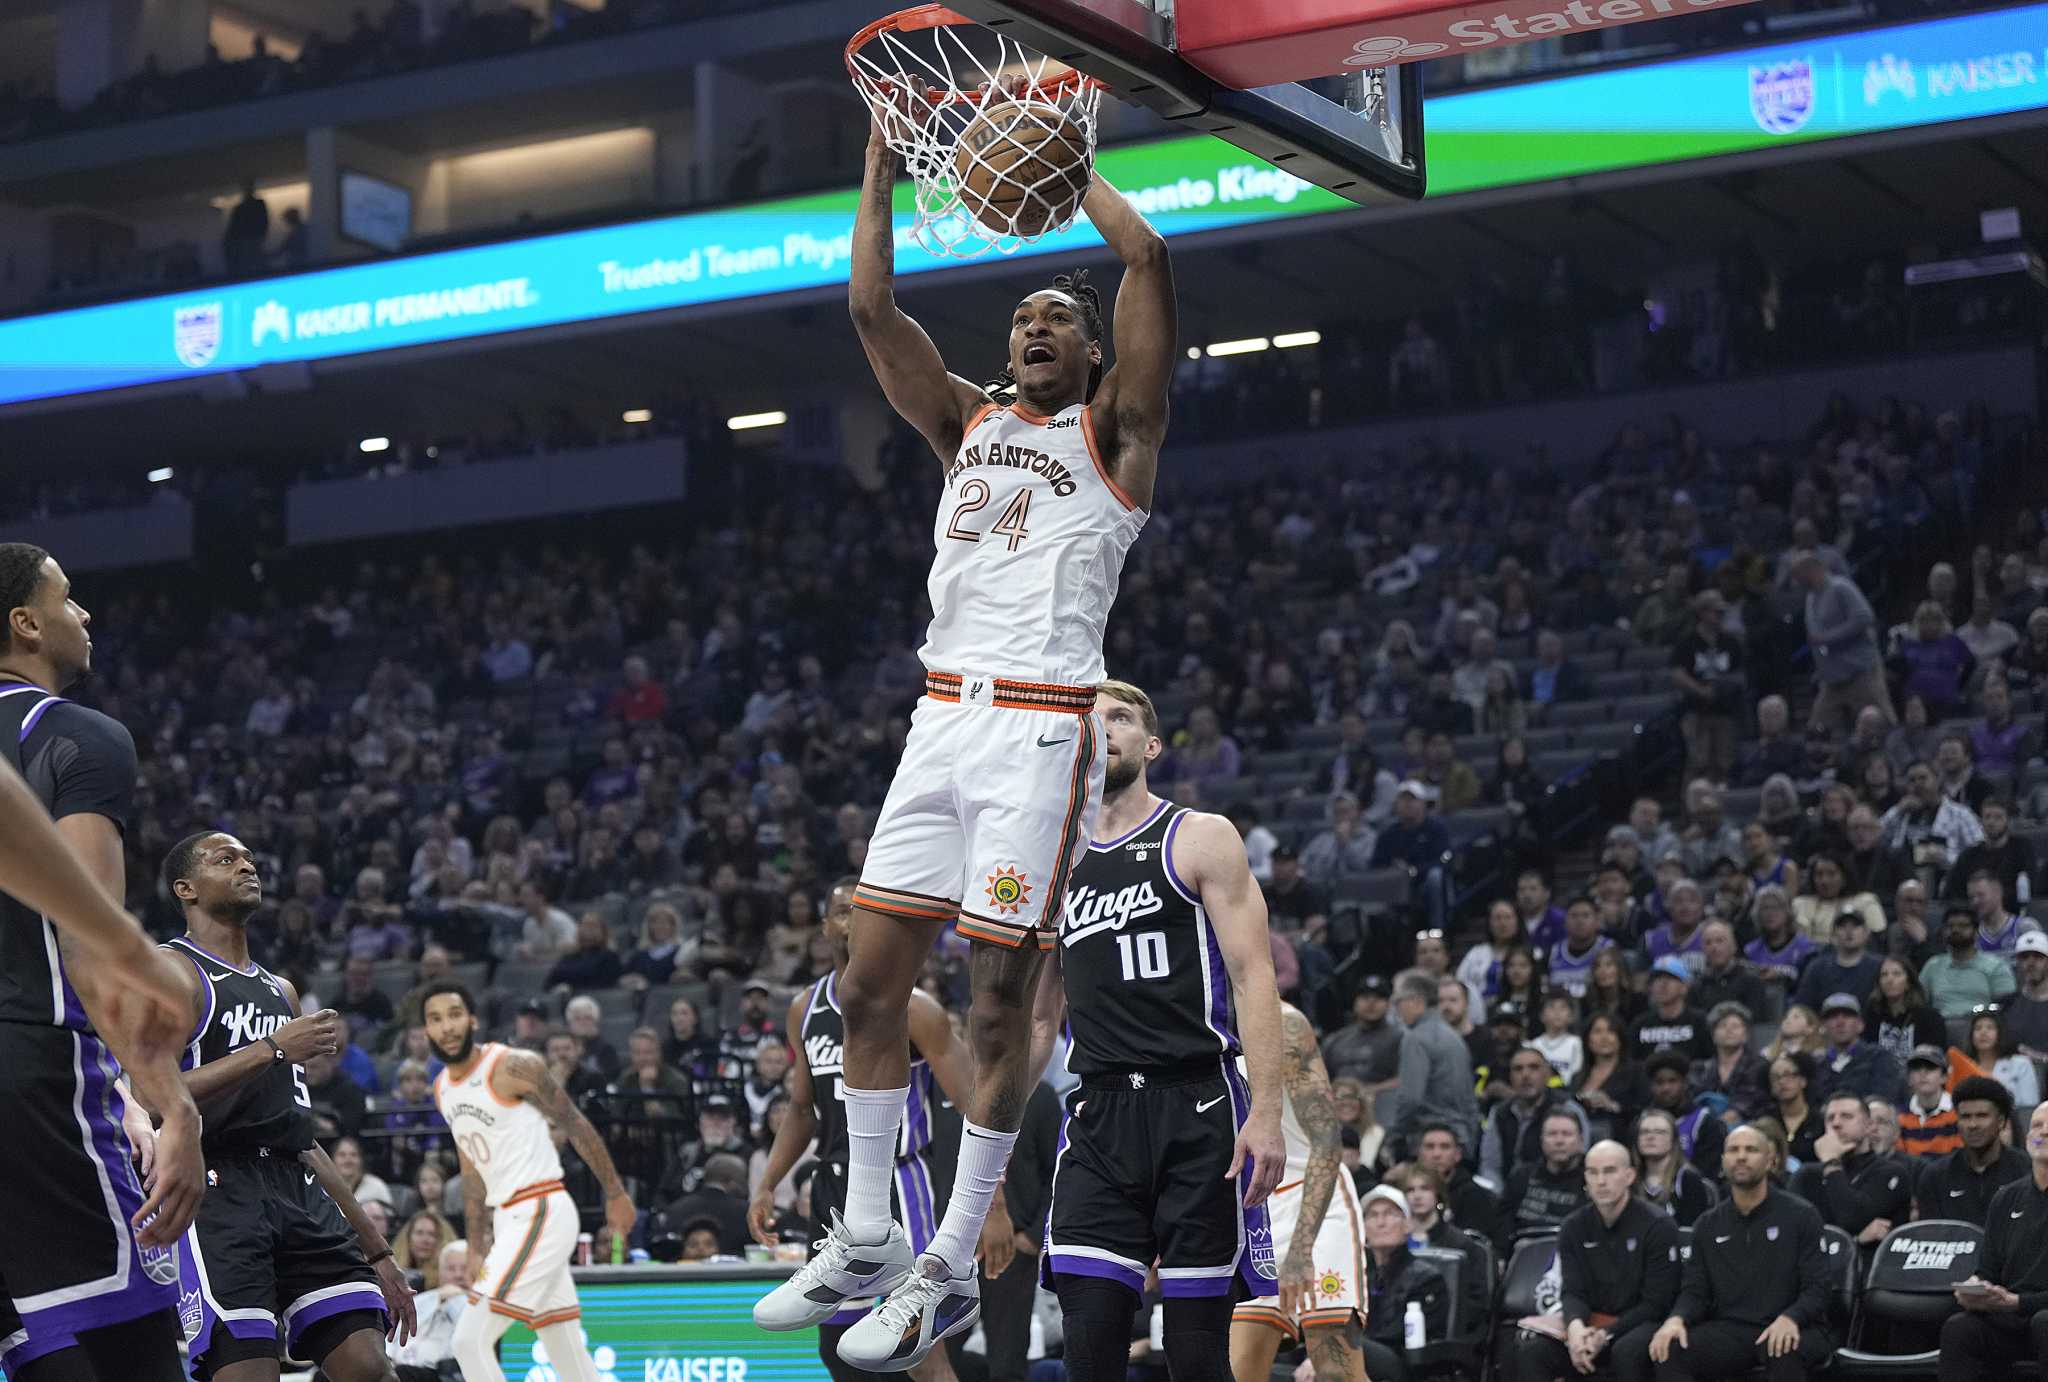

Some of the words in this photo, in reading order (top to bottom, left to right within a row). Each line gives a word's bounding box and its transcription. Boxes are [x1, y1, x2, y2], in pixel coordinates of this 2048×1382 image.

[1928, 52, 2037, 97] KAISER
[599, 250, 701, 294] Trusted
[704, 243, 780, 278] Team
[297, 302, 371, 339] KAISER
[987, 443, 1077, 498] ANTONIO
[947, 478, 1033, 552] 24
[1125, 841, 1161, 851] dialpad
[1059, 880, 1163, 940] Kings
[1116, 931, 1170, 981] 10
[805, 1034, 843, 1067] Kin
[291, 1063, 312, 1109] 5
[1903, 1252, 1956, 1269] FIRM
[644, 1357, 748, 1382] KAISER
